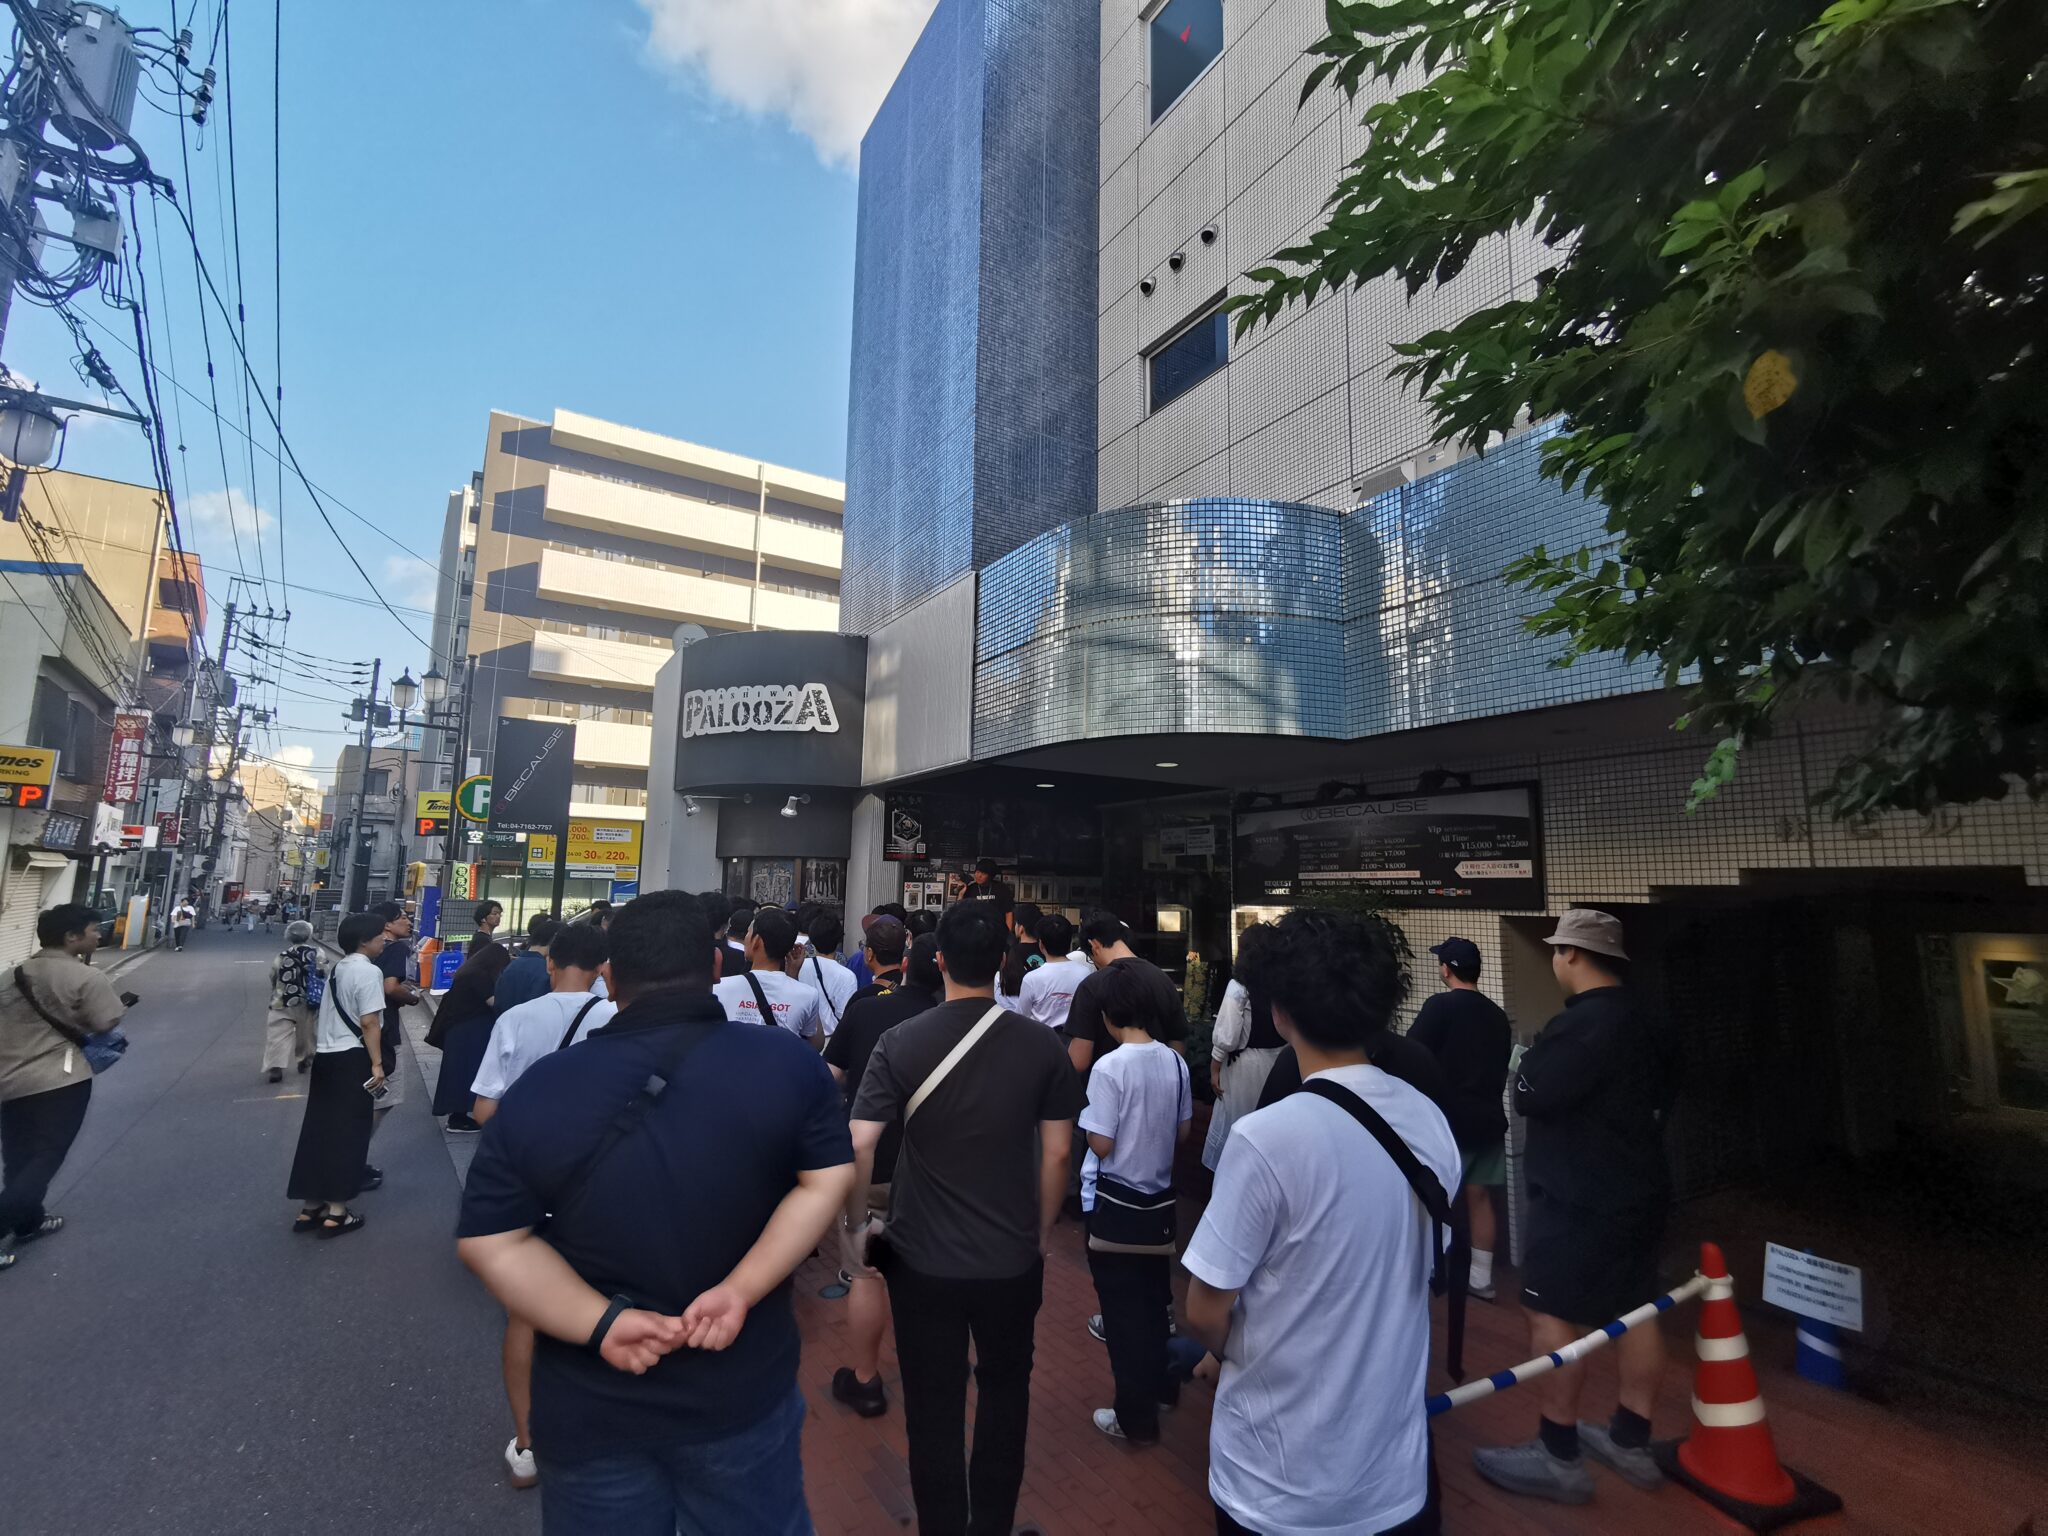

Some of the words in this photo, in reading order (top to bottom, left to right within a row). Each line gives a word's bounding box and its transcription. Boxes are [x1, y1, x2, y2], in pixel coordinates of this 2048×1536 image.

[707, 689, 793, 701] KASHIWA
[685, 690, 832, 732] PALOOZA
[504, 728, 564, 802] BECAUSE
[18, 785, 43, 807] P
[1319, 800, 1429, 819] BECAUSE
[420, 819, 434, 835] P
[1428, 826, 1442, 834] Vip
[467, 831, 484, 844] 空
